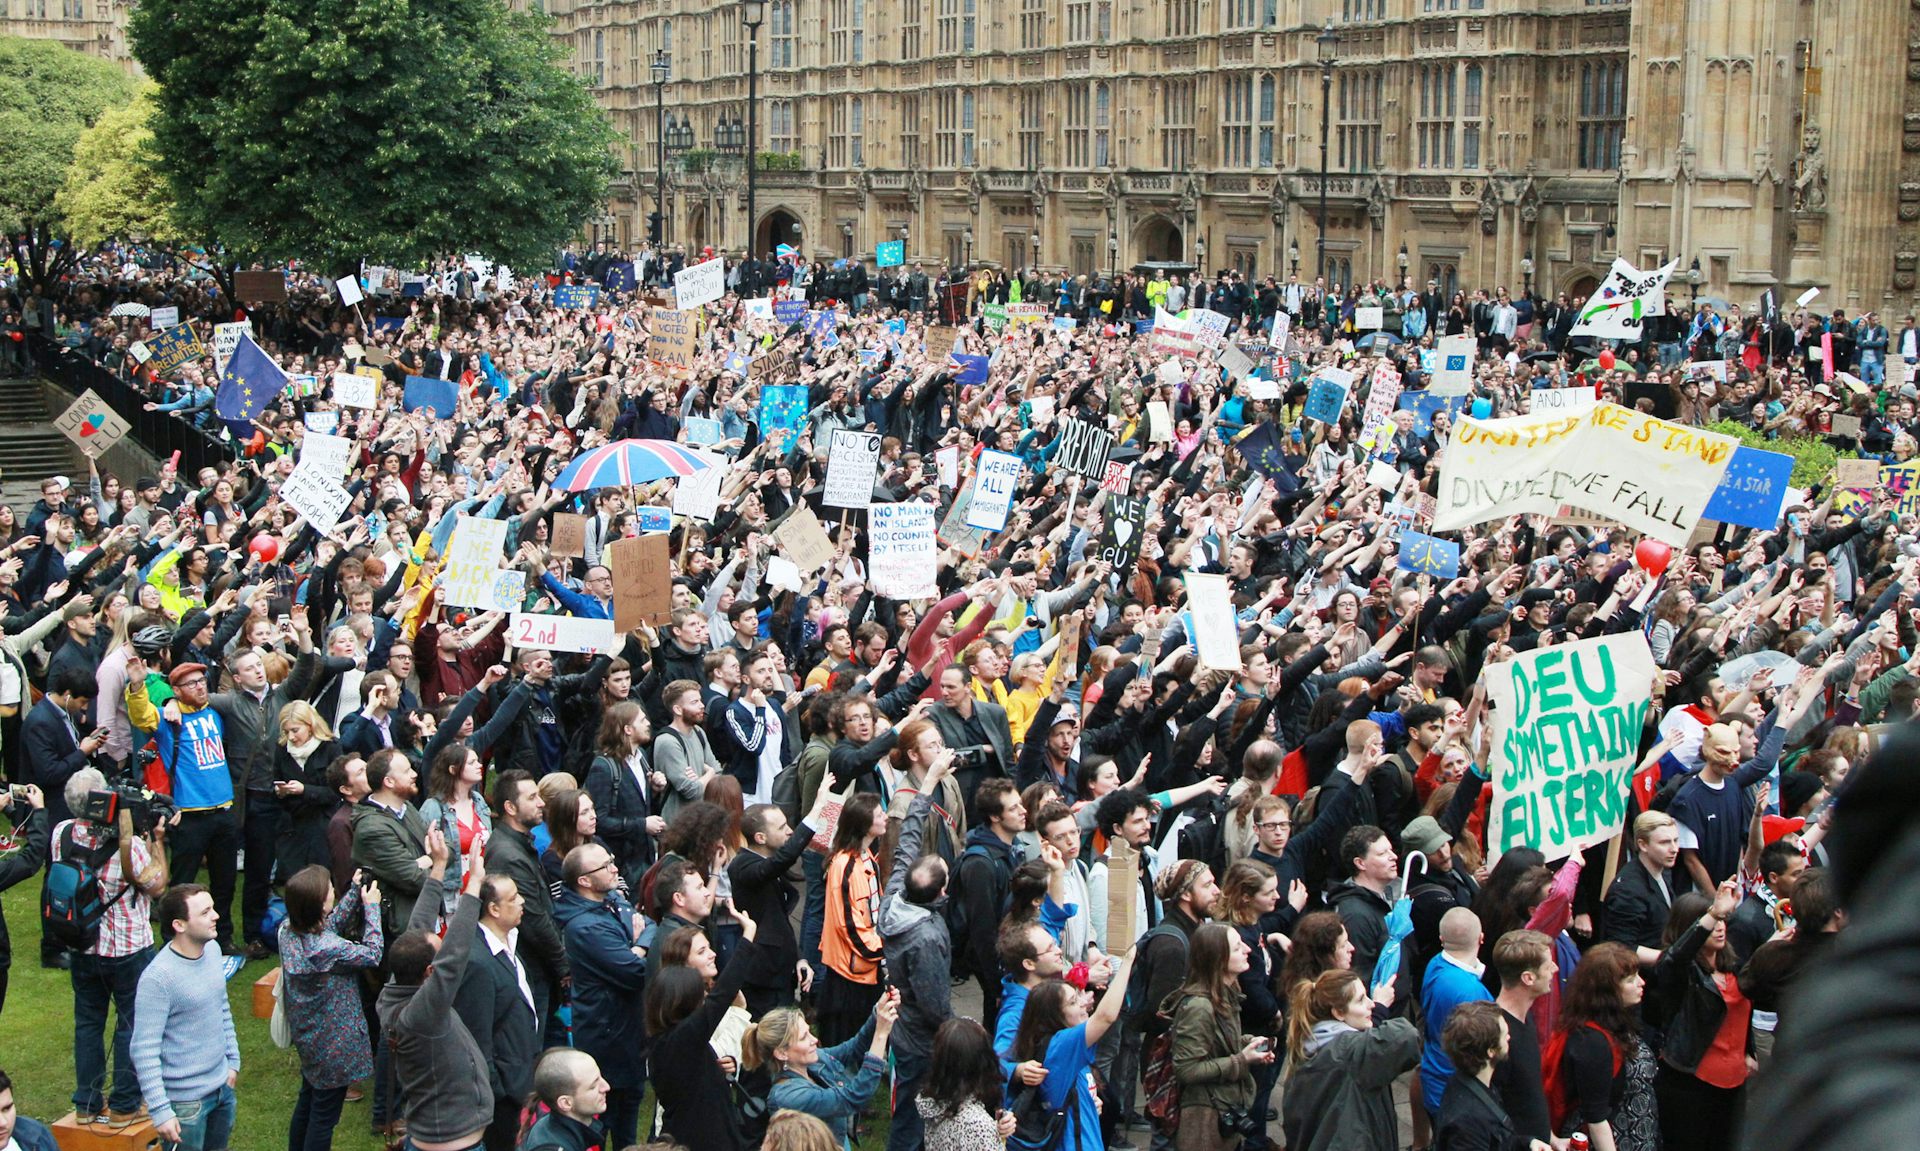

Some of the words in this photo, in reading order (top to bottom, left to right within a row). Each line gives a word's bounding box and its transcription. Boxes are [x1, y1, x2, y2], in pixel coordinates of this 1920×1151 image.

[656, 311, 690, 324] NOBODY
[1007, 305, 1018, 313] WE
[1019, 305, 1047, 313] REMAIN
[659, 324, 688, 335] VOTED
[1622, 318, 1641, 328] OU
[158, 346, 175, 358] WILL
[175, 339, 188, 348] BE
[160, 334, 175, 346] WE
[224, 336, 235, 344] AN
[671, 337, 685, 346] NO
[156, 342, 201, 371] REUNITED
[653, 348, 687, 365] PLAN
[752, 350, 785, 375] STAND
[60, 391, 101, 431] LONDON
[1370, 412, 1385, 426] LOL
[92, 421, 121, 451] EU
[834, 432, 858, 449] NO
[1459, 415, 1581, 448] UNITED
[1633, 418, 1730, 465] STAND
[1056, 417, 1114, 480] BREXSHIT
[985, 460, 999, 473] WE
[1001, 462, 1018, 476] ARE
[1108, 462, 1126, 475] STOP
[293, 470, 320, 495] STANDS
[304, 462, 346, 504] LONDON
[827, 481, 839, 489] WE
[841, 482, 855, 490] ARE
[857, 483, 869, 491] ALL
[981, 477, 1004, 495] ALL
[1100, 472, 1130, 496] BREXIT
[1733, 478, 1741, 489] A
[1744, 476, 1772, 496] STAR
[824, 490, 871, 501] IMMIGRANTS
[1569, 471, 1610, 495] WE
[1612, 480, 1687, 531] FALL
[288, 486, 328, 527] EUROPE
[322, 497, 342, 518] WITH
[874, 506, 892, 517] NO
[898, 506, 922, 517] MAN
[925, 507, 934, 515] IS
[972, 500, 1008, 516] IMMIGRANTS
[1113, 495, 1141, 523] WE
[468, 517, 500, 538] LET
[559, 525, 577, 537] ARE
[874, 520, 887, 528] AN
[892, 517, 929, 529] ISLAND
[873, 532, 889, 541] NO
[891, 530, 935, 541] COUNTRY
[466, 540, 493, 561] ME
[874, 545, 887, 555] BY
[893, 543, 929, 553] ITSELF
[451, 562, 495, 588] BACK
[456, 585, 481, 604] IN
[519, 619, 557, 645] 2nd
[185, 713, 219, 740] I'M
[193, 734, 225, 766] IN
[1501, 791, 1542, 854] EU
